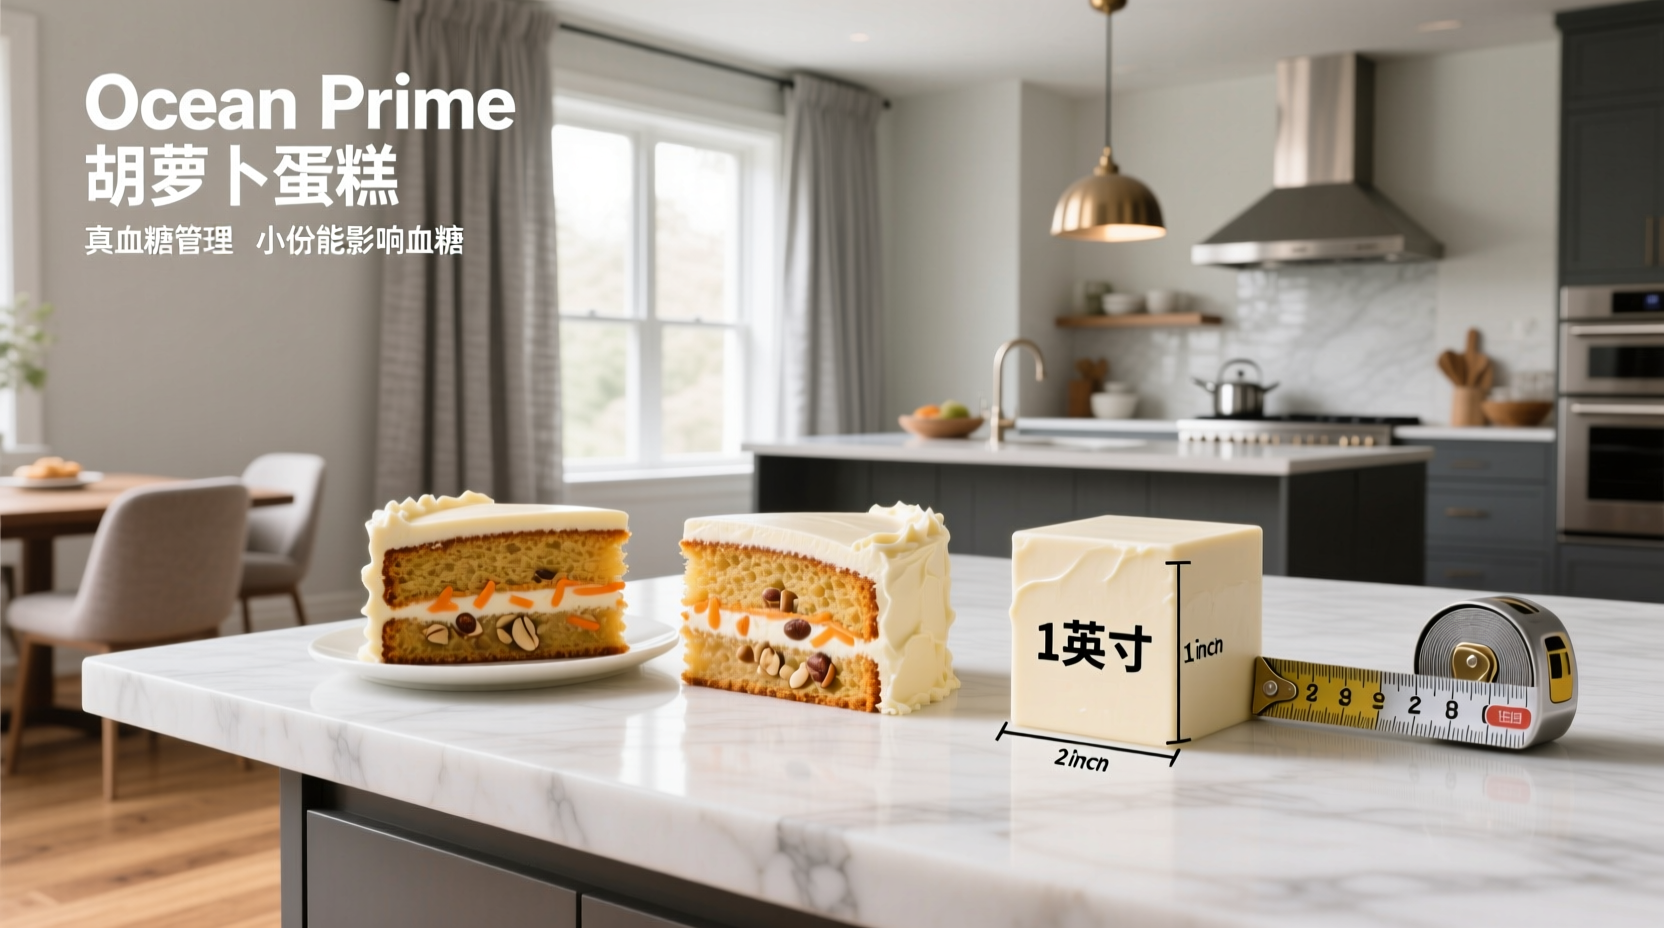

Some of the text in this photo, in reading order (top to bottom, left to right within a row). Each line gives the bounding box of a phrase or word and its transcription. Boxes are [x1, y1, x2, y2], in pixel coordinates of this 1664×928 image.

[1305, 683, 1319, 703] 2
[1407, 695, 1422, 715] 2
[1445, 700, 1459, 720] 8
